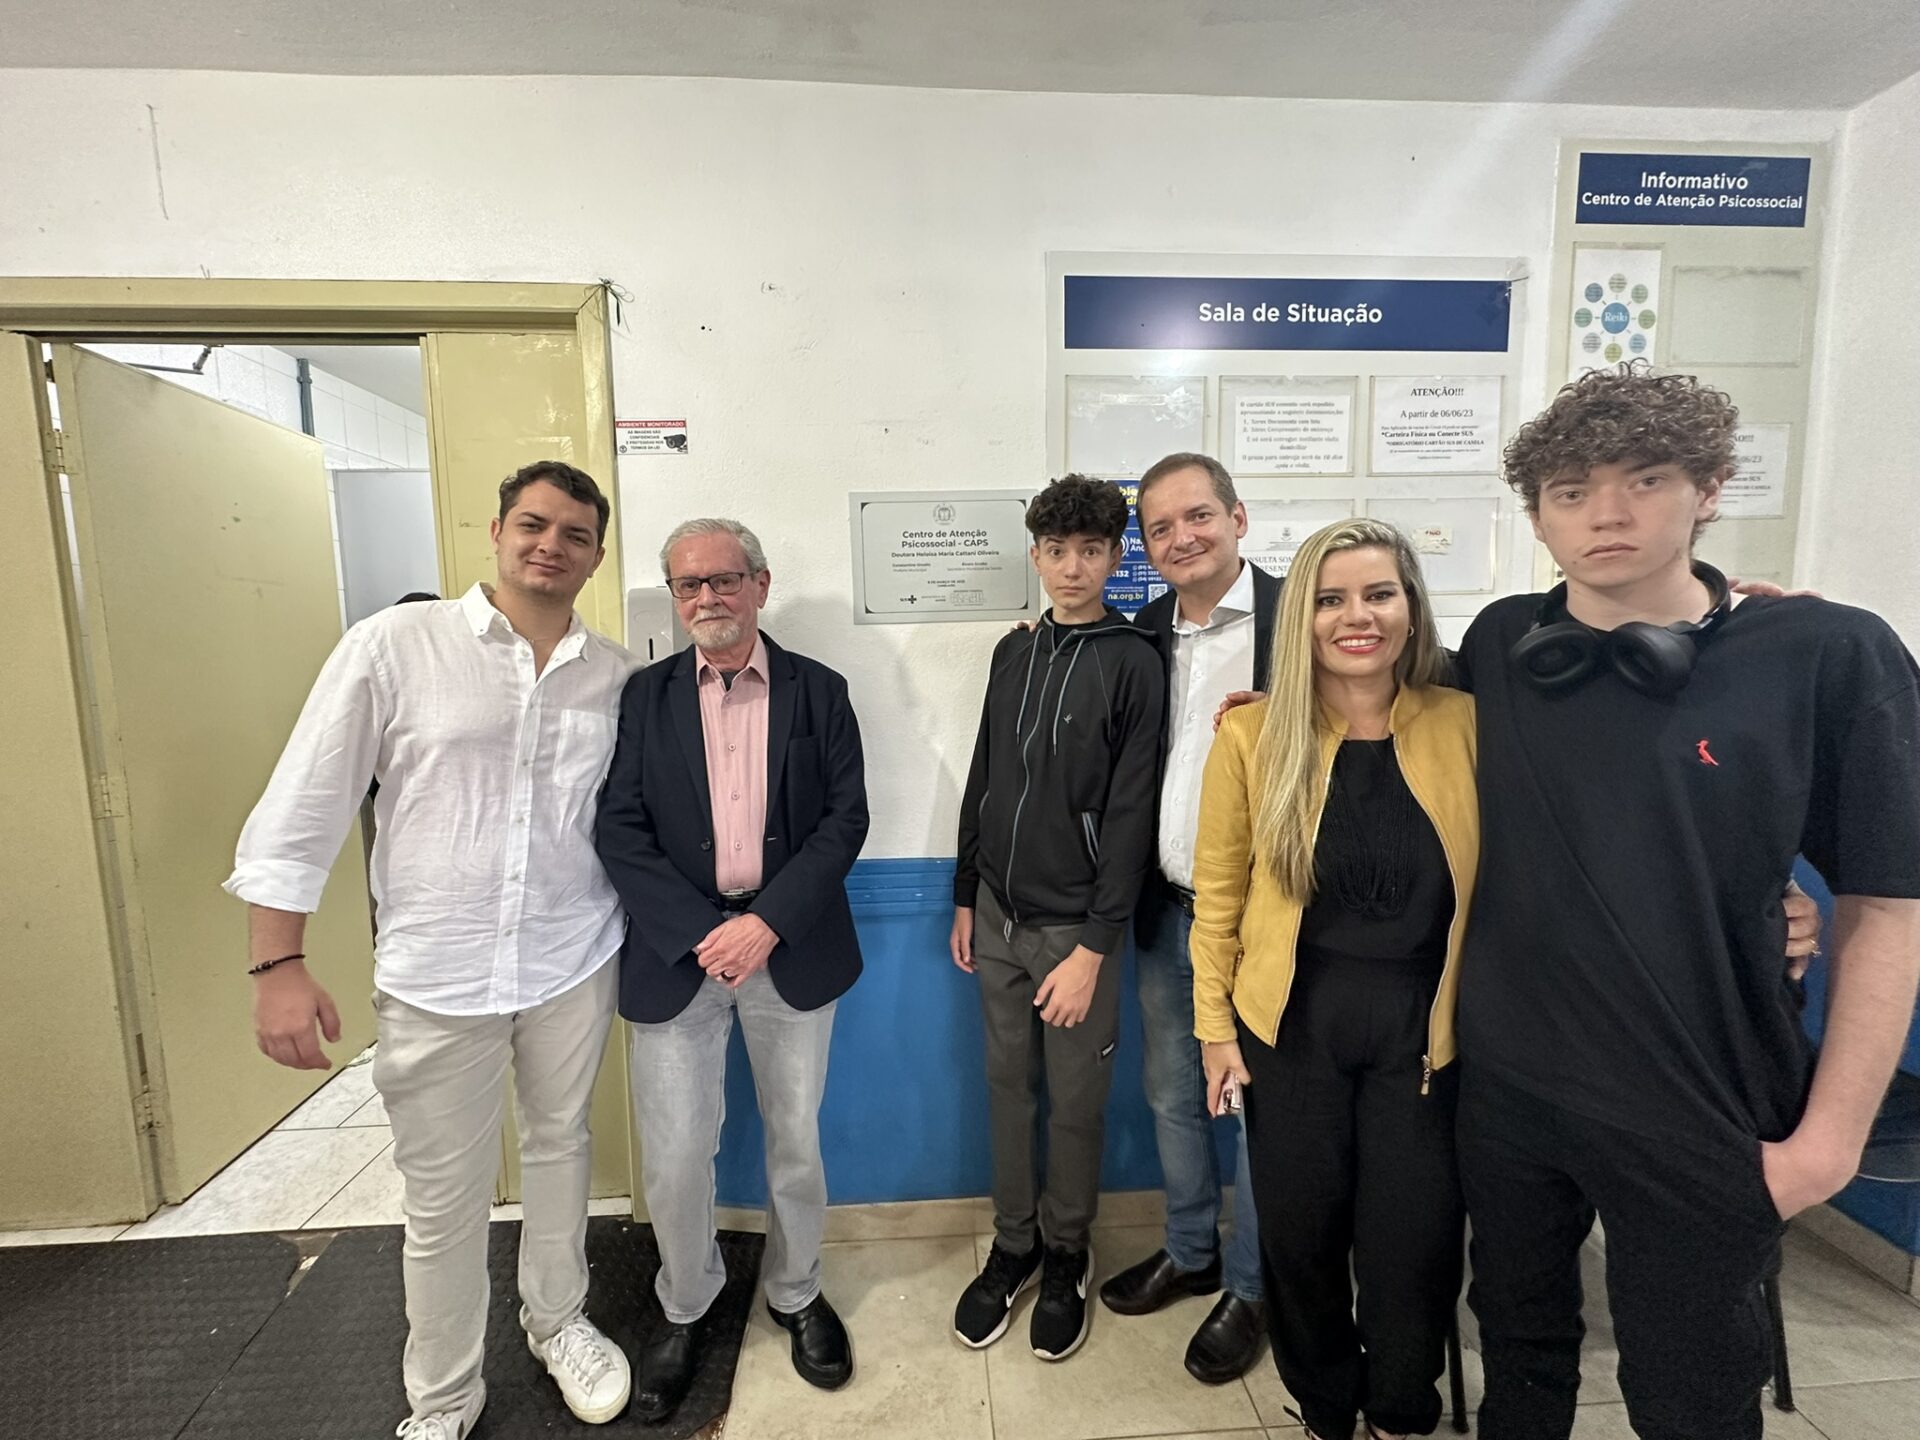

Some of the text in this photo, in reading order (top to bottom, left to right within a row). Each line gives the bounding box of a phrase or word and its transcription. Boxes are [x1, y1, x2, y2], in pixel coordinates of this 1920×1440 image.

[1641, 171, 1749, 190] Informativo
[1582, 192, 1803, 209] Centro de Atenção Psicossocial
[1199, 302, 1383, 327] Sala de Situação
[1604, 311, 1628, 322] Reiki
[1410, 386, 1464, 397] ATENÇÃO!!!
[1400, 409, 1474, 420] A partir de 06/06/23
[902, 529, 987, 540] Centro de Atenção
[901, 540, 956, 549] Psicossocial
[963, 539, 989, 548] CAPS
[1107, 592, 1144, 602] na.org.br
